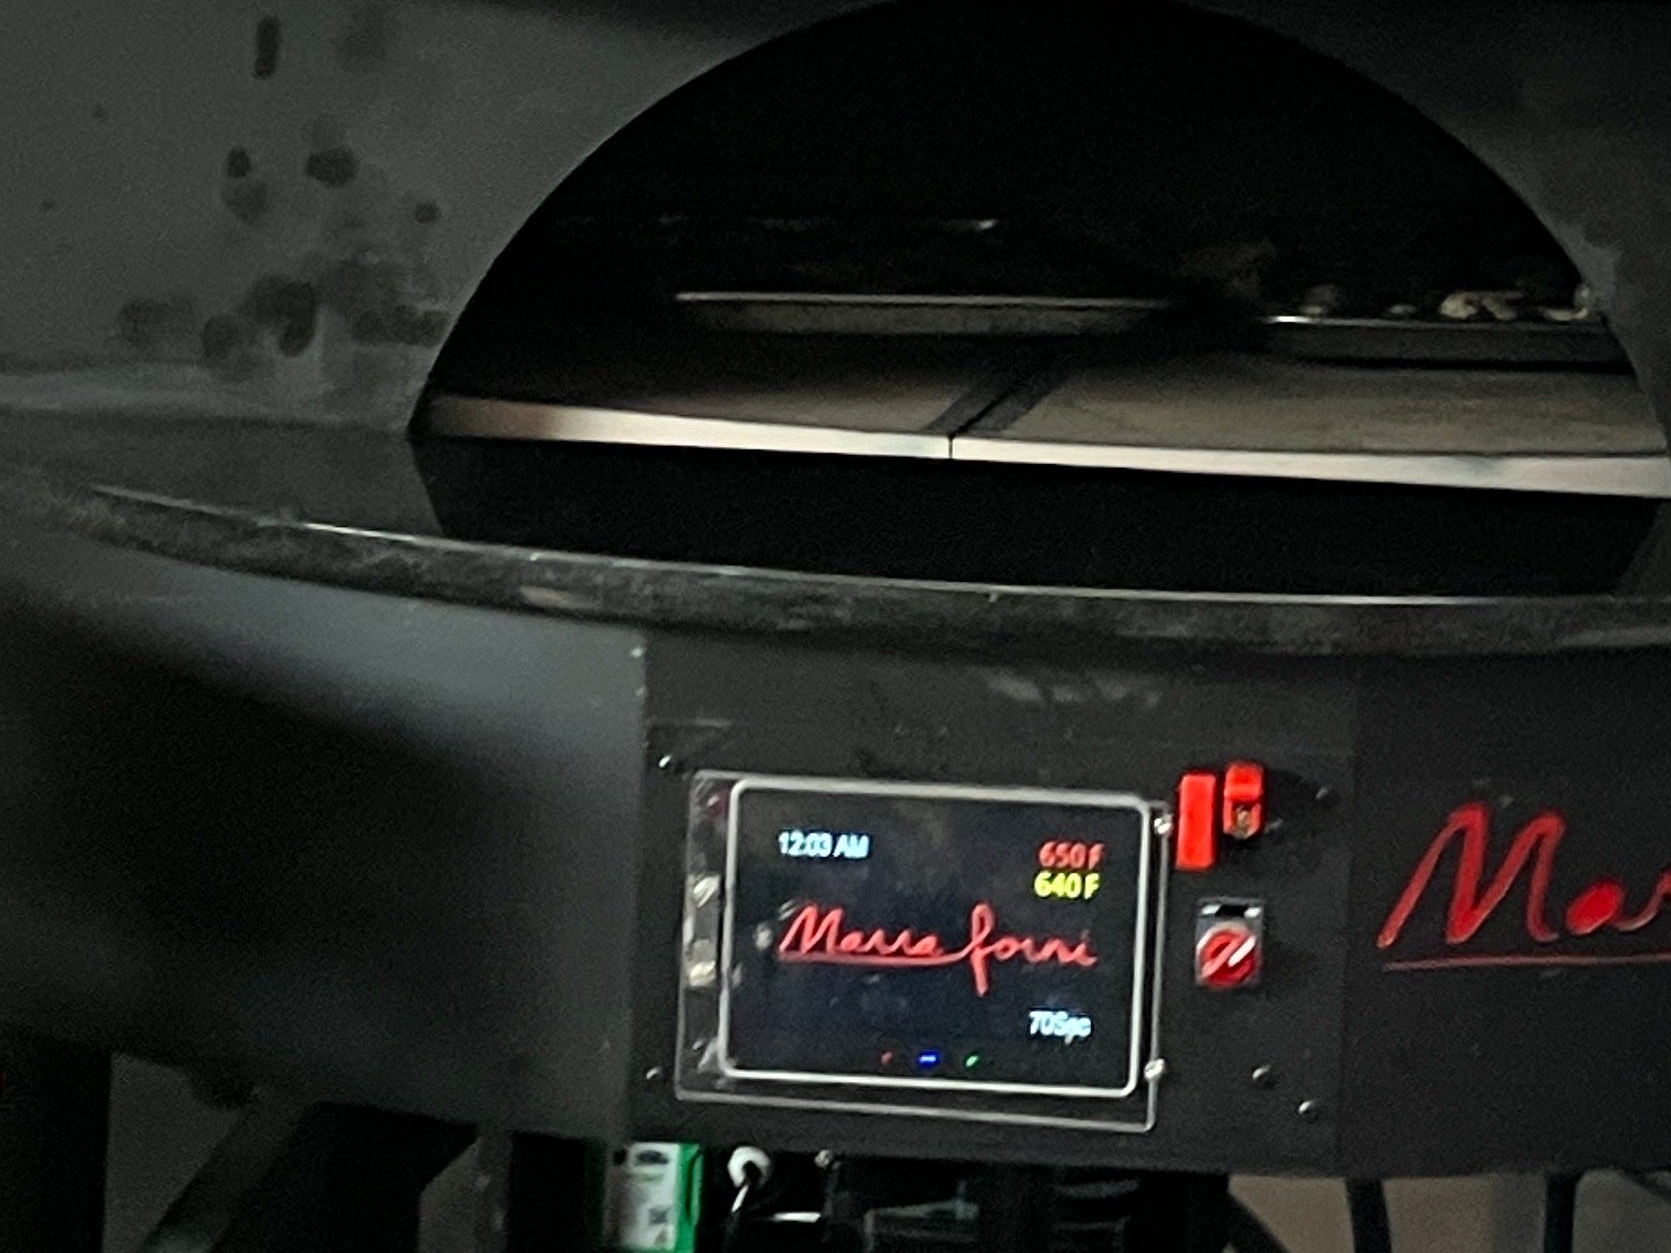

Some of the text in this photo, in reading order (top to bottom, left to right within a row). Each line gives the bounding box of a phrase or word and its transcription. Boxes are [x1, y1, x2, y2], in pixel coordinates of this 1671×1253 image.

[833, 833, 869, 859] AM
[1039, 841, 1087, 868] 650
[1034, 870, 1099, 900] 640 F
